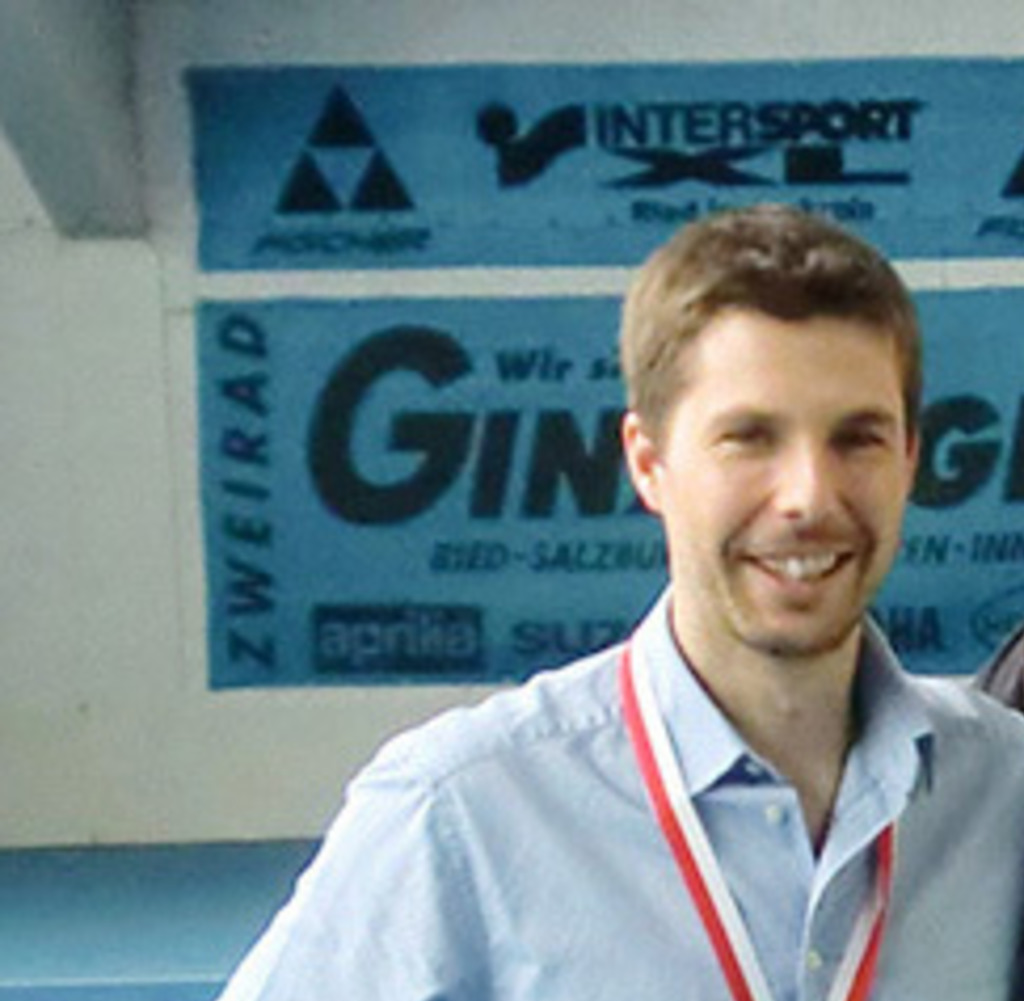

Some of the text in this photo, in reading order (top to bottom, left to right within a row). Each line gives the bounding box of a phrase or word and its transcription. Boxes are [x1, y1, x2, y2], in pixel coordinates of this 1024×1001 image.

[599, 99, 922, 144] INTERSPORT
[496, 351, 572, 380] Wir
[218, 313, 274, 668] ZWEIRAD
[318, 612, 477, 660] aprilia
